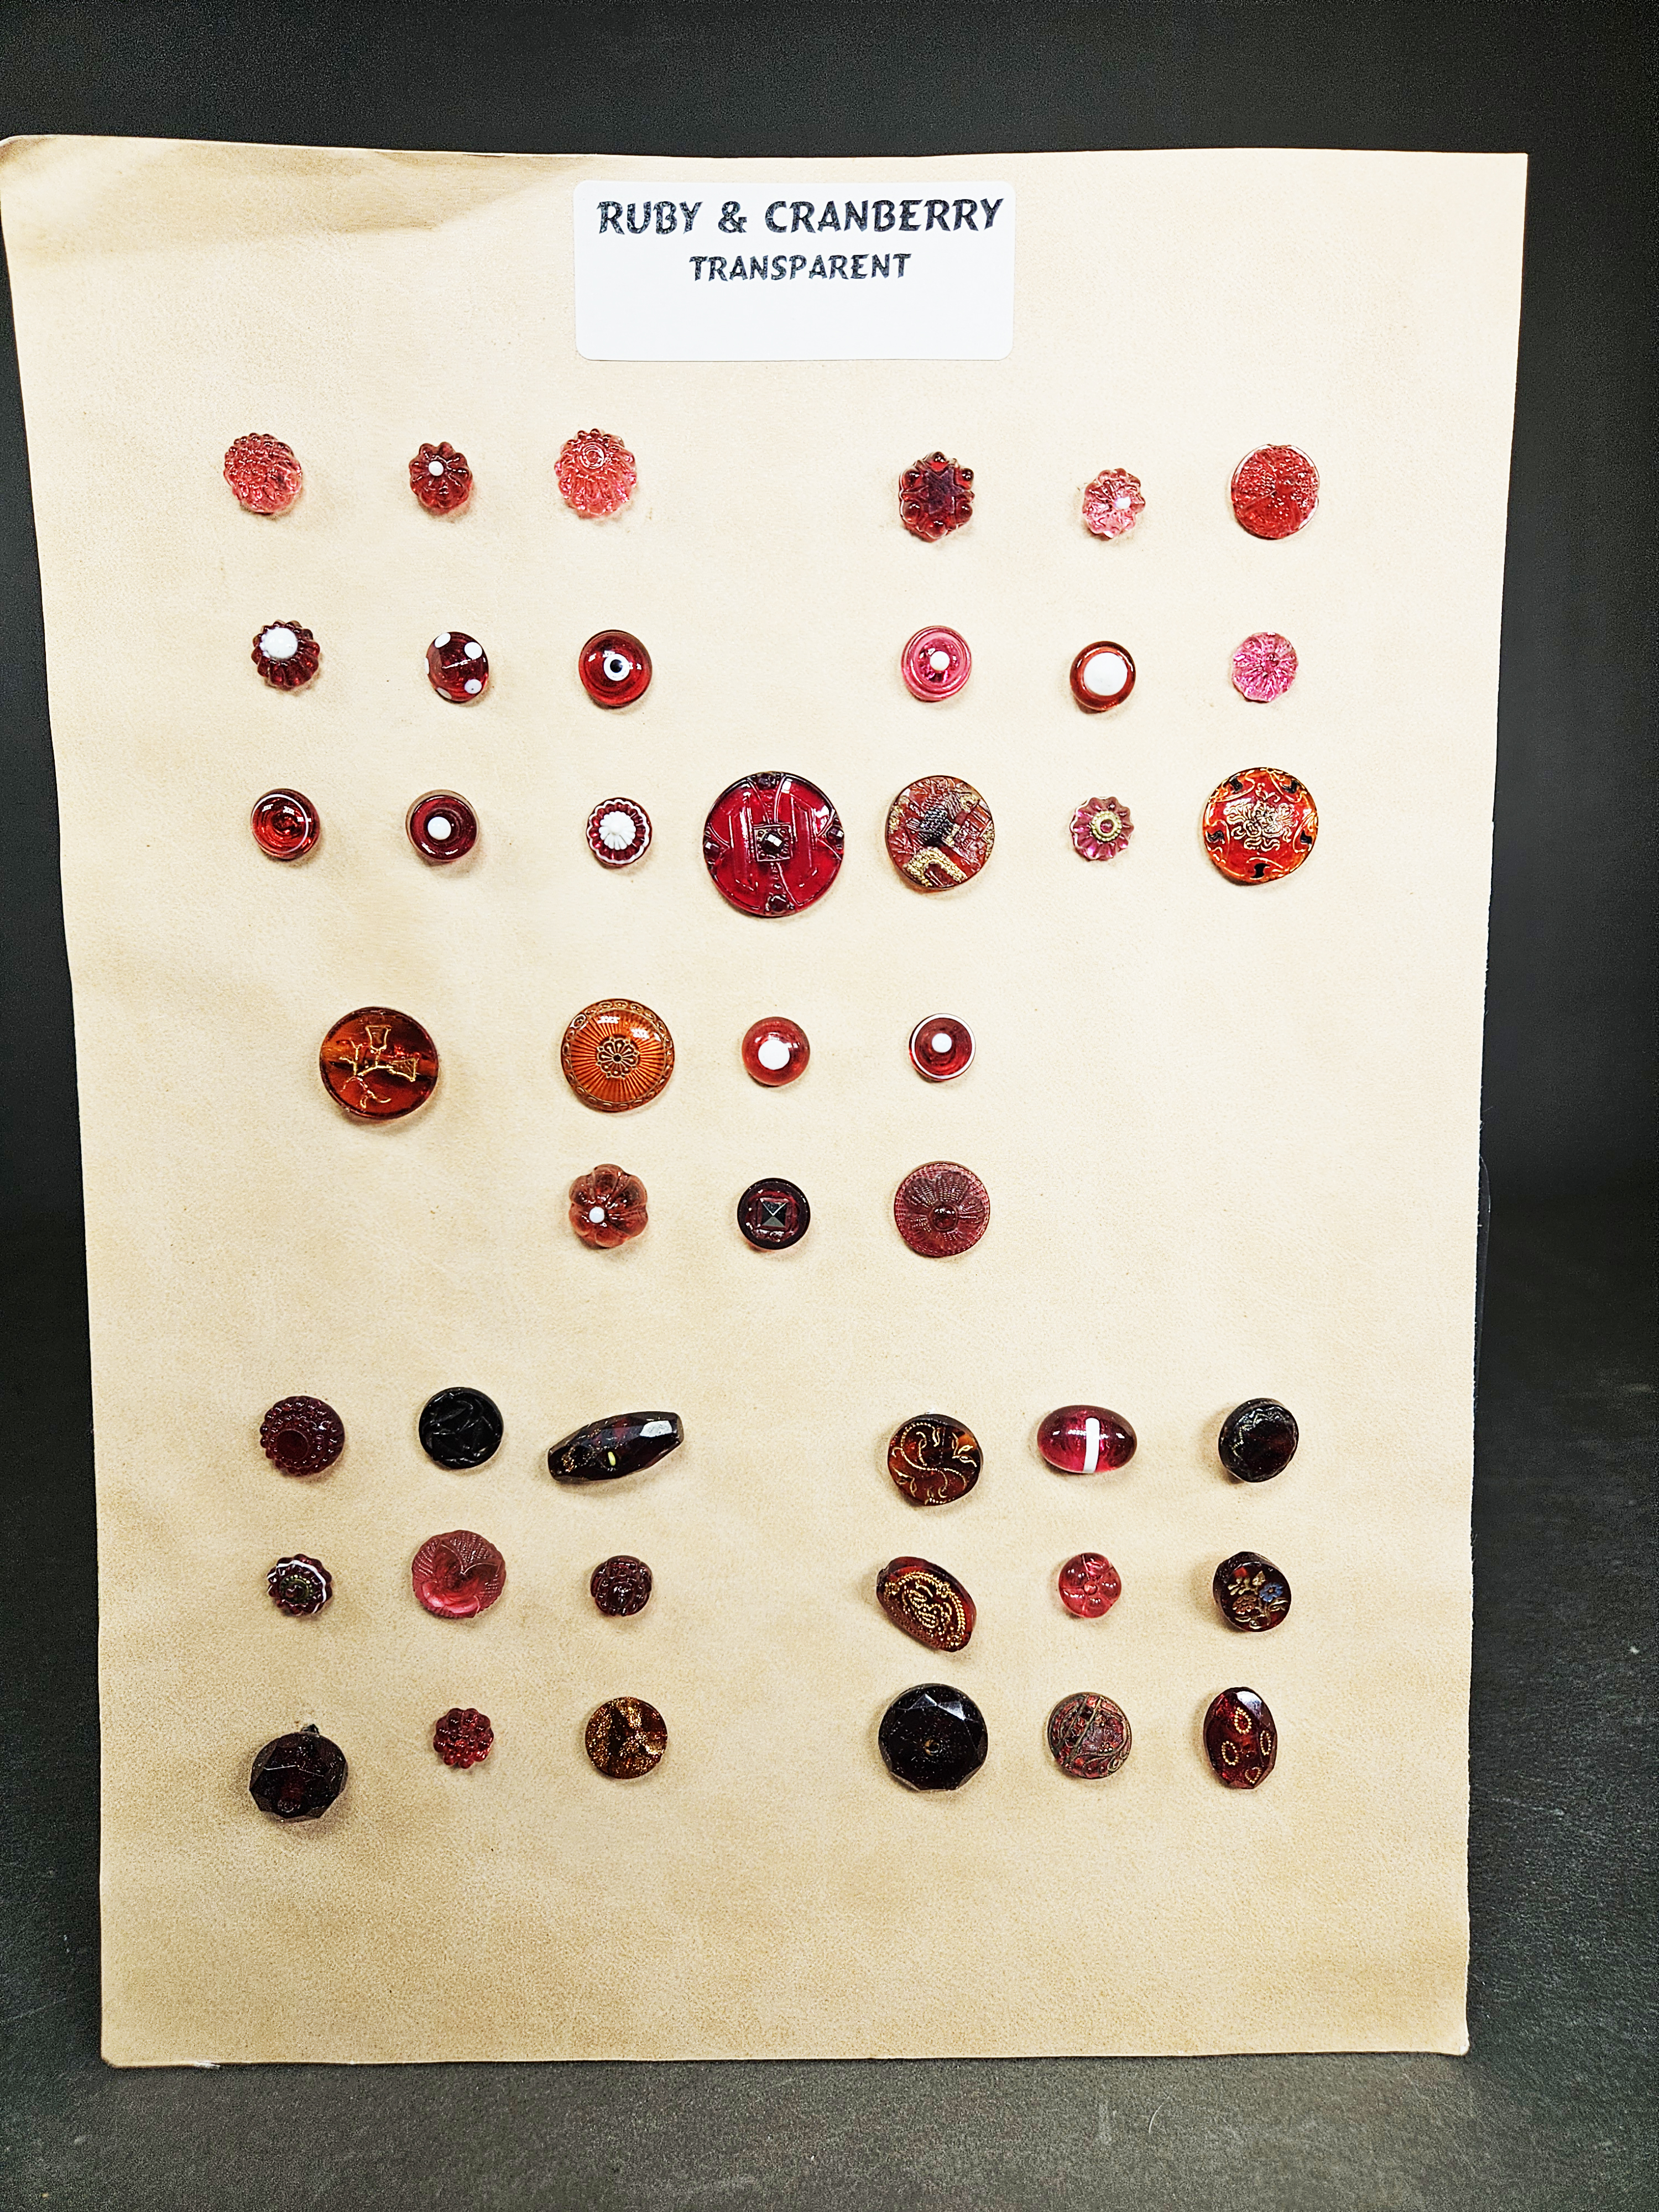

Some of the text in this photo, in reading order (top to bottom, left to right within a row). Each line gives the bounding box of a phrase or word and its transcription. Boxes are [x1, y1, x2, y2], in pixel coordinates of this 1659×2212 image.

[597, 198, 1004, 234] RUBY & CRANBERRY
[689, 253, 912, 281] TRANSPARENT
